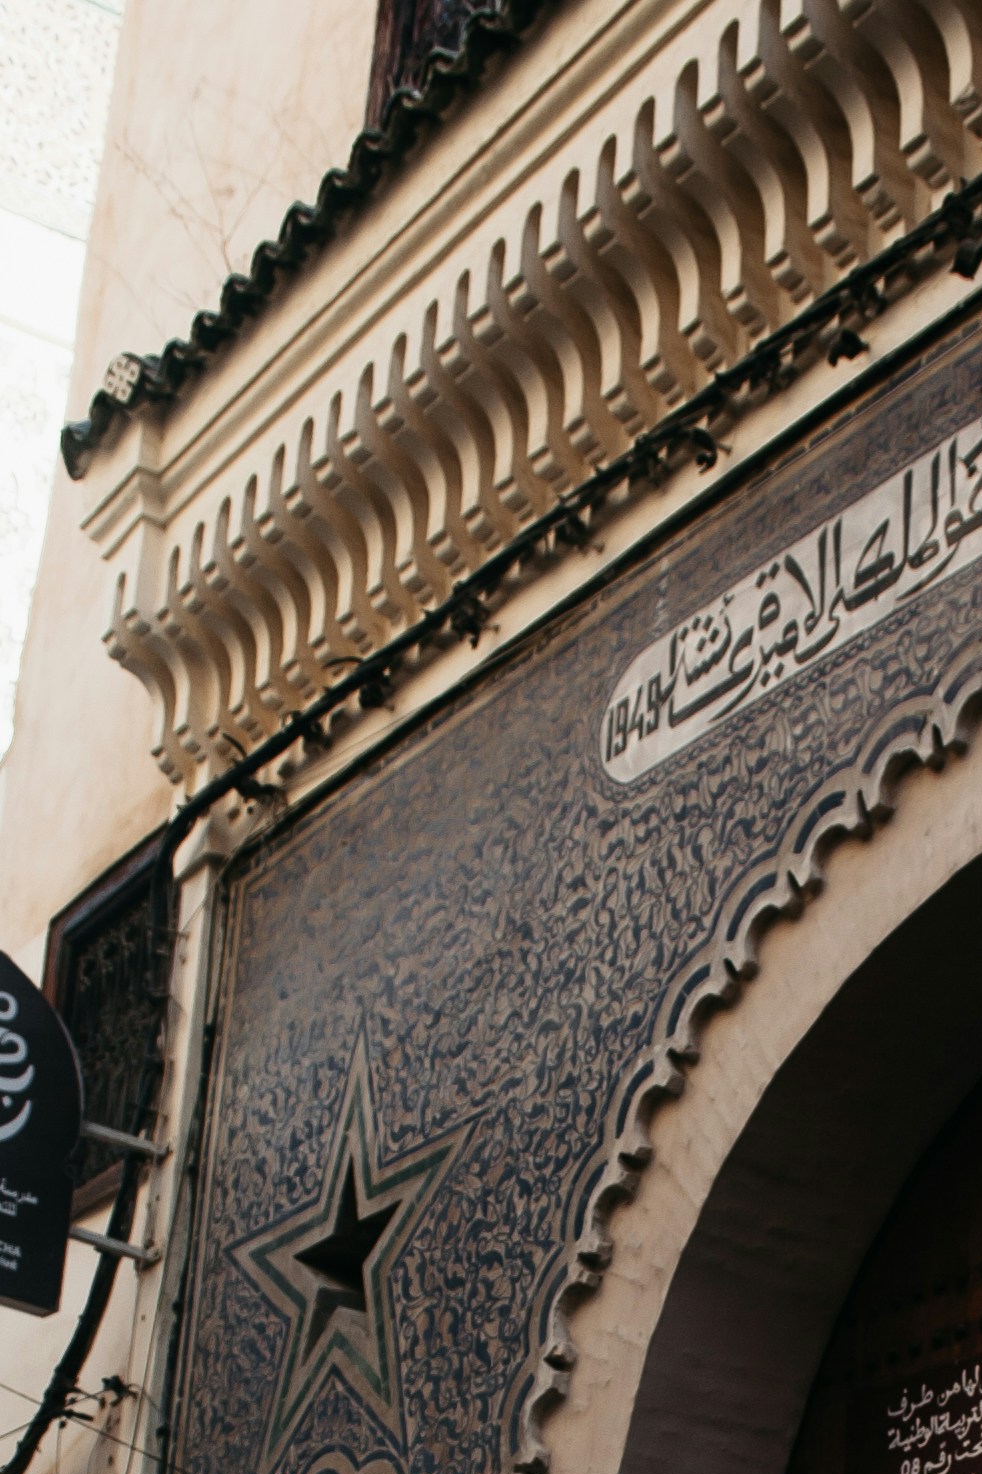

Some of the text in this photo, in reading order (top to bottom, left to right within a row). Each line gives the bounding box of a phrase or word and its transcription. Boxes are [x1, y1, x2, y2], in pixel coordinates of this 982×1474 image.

[605, 671, 662, 763] 1949
[937, 1382, 961, 1407] من
[962, 1364, 980, 1397] لها
[888, 1383, 934, 1421] طرف
[887, 1415, 939, 1452] الوطنية
